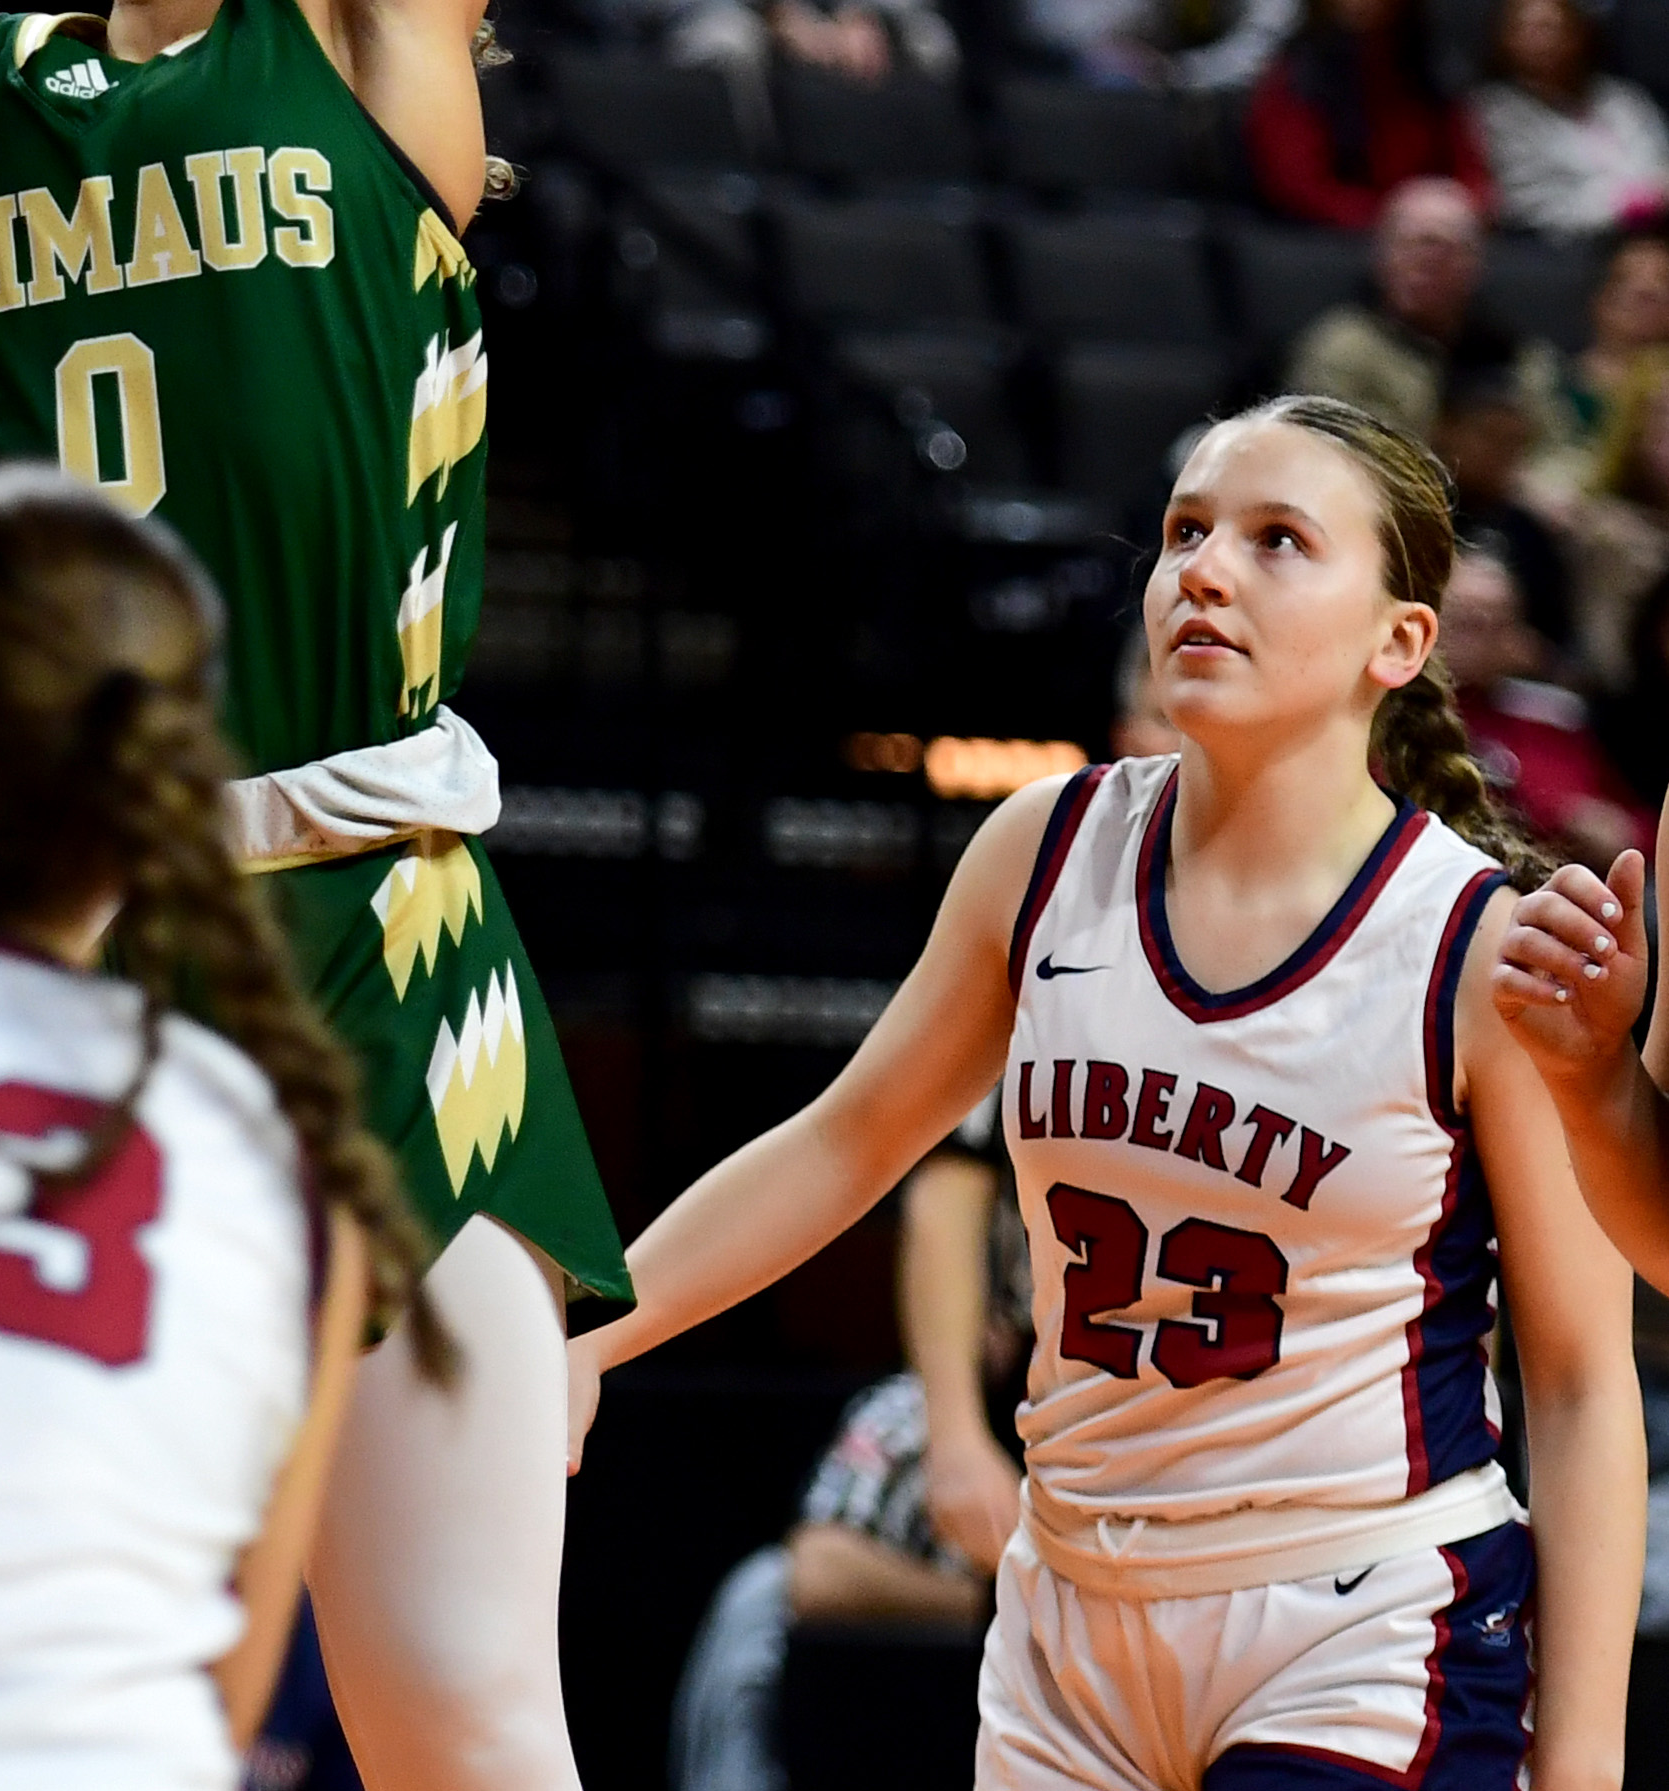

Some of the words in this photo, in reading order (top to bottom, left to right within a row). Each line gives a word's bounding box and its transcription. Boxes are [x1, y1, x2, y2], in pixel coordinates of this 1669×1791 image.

[55, 332, 167, 520] 0
[1018, 1059, 1352, 1212] LIBERTY
[1045, 1181, 1290, 1389] 23
